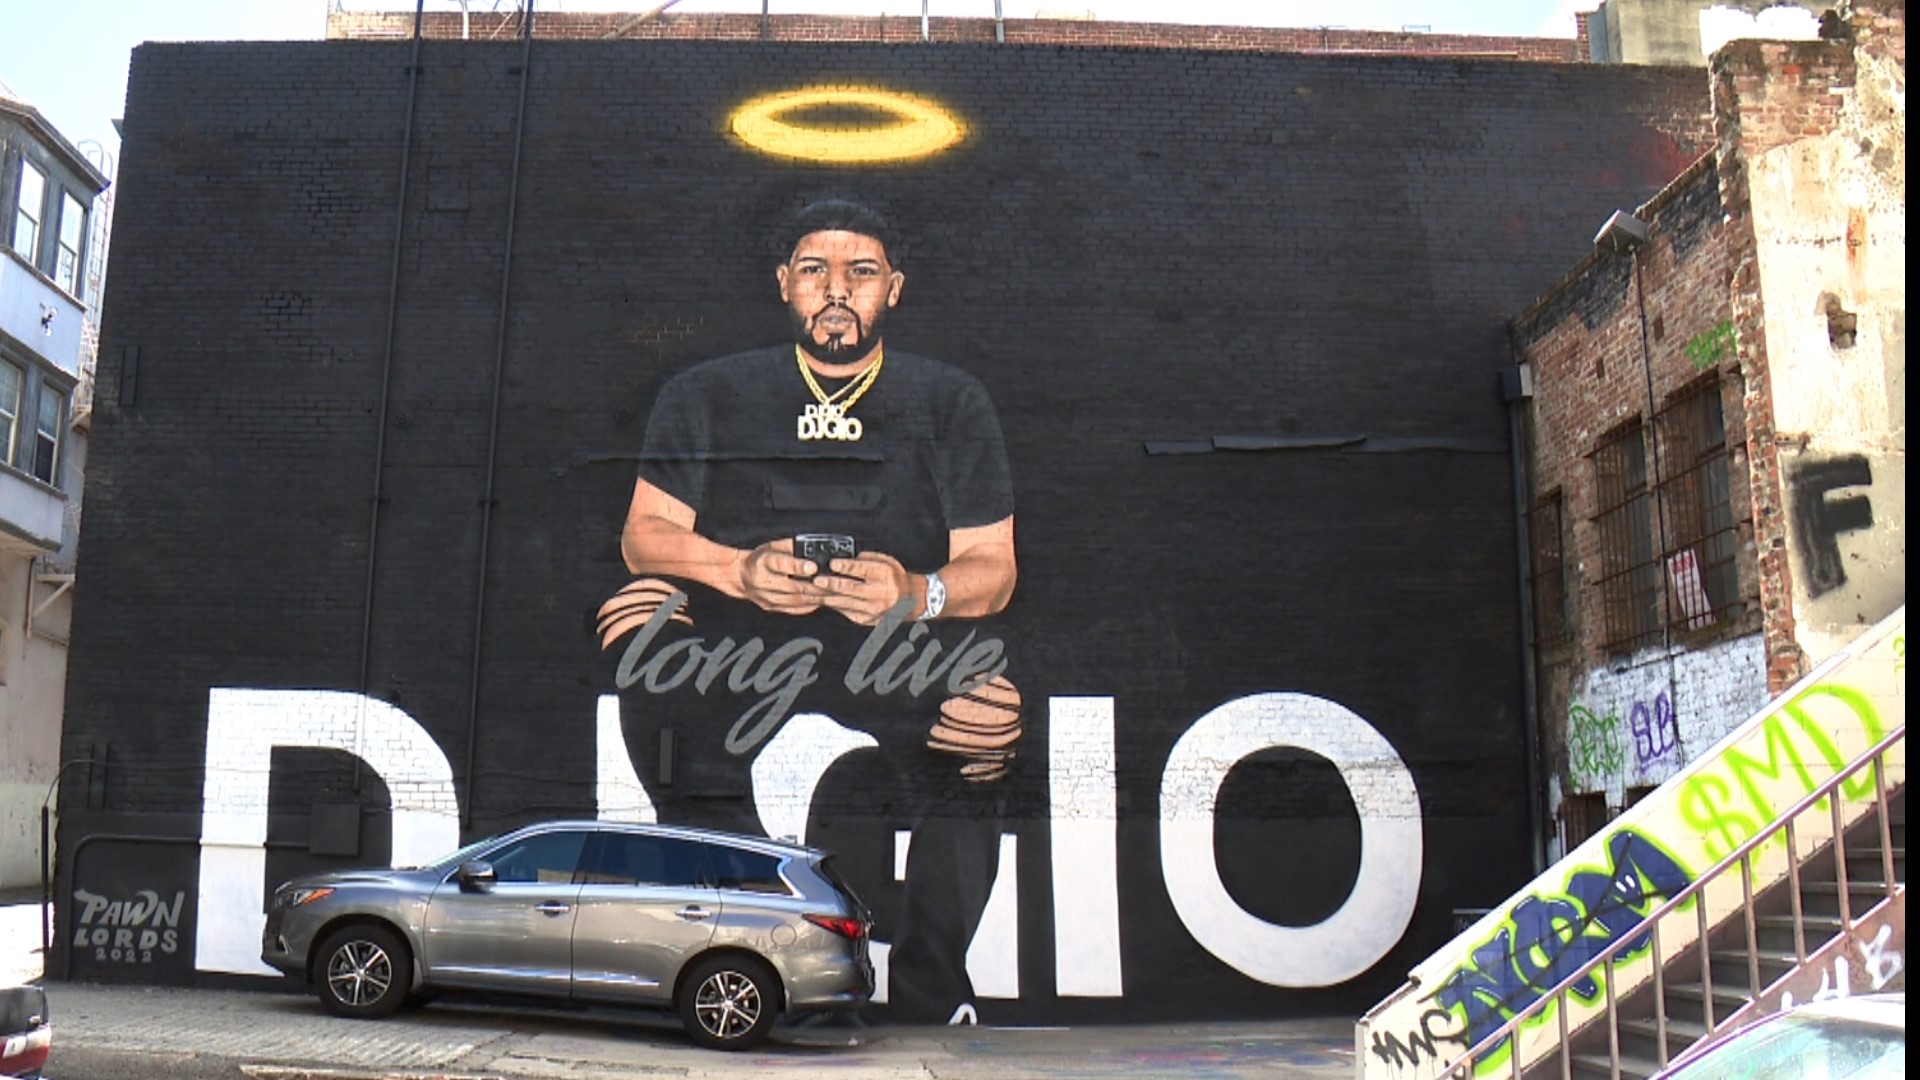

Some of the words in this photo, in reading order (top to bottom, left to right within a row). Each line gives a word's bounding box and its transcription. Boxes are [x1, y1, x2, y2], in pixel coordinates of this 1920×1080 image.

[1789, 453, 1874, 599] F
[615, 591, 823, 755] long
[844, 597, 1008, 698] live
[73, 888, 185, 928] PAWN
[73, 928, 178, 954] LORDS
[95, 947, 152, 964] 2022
